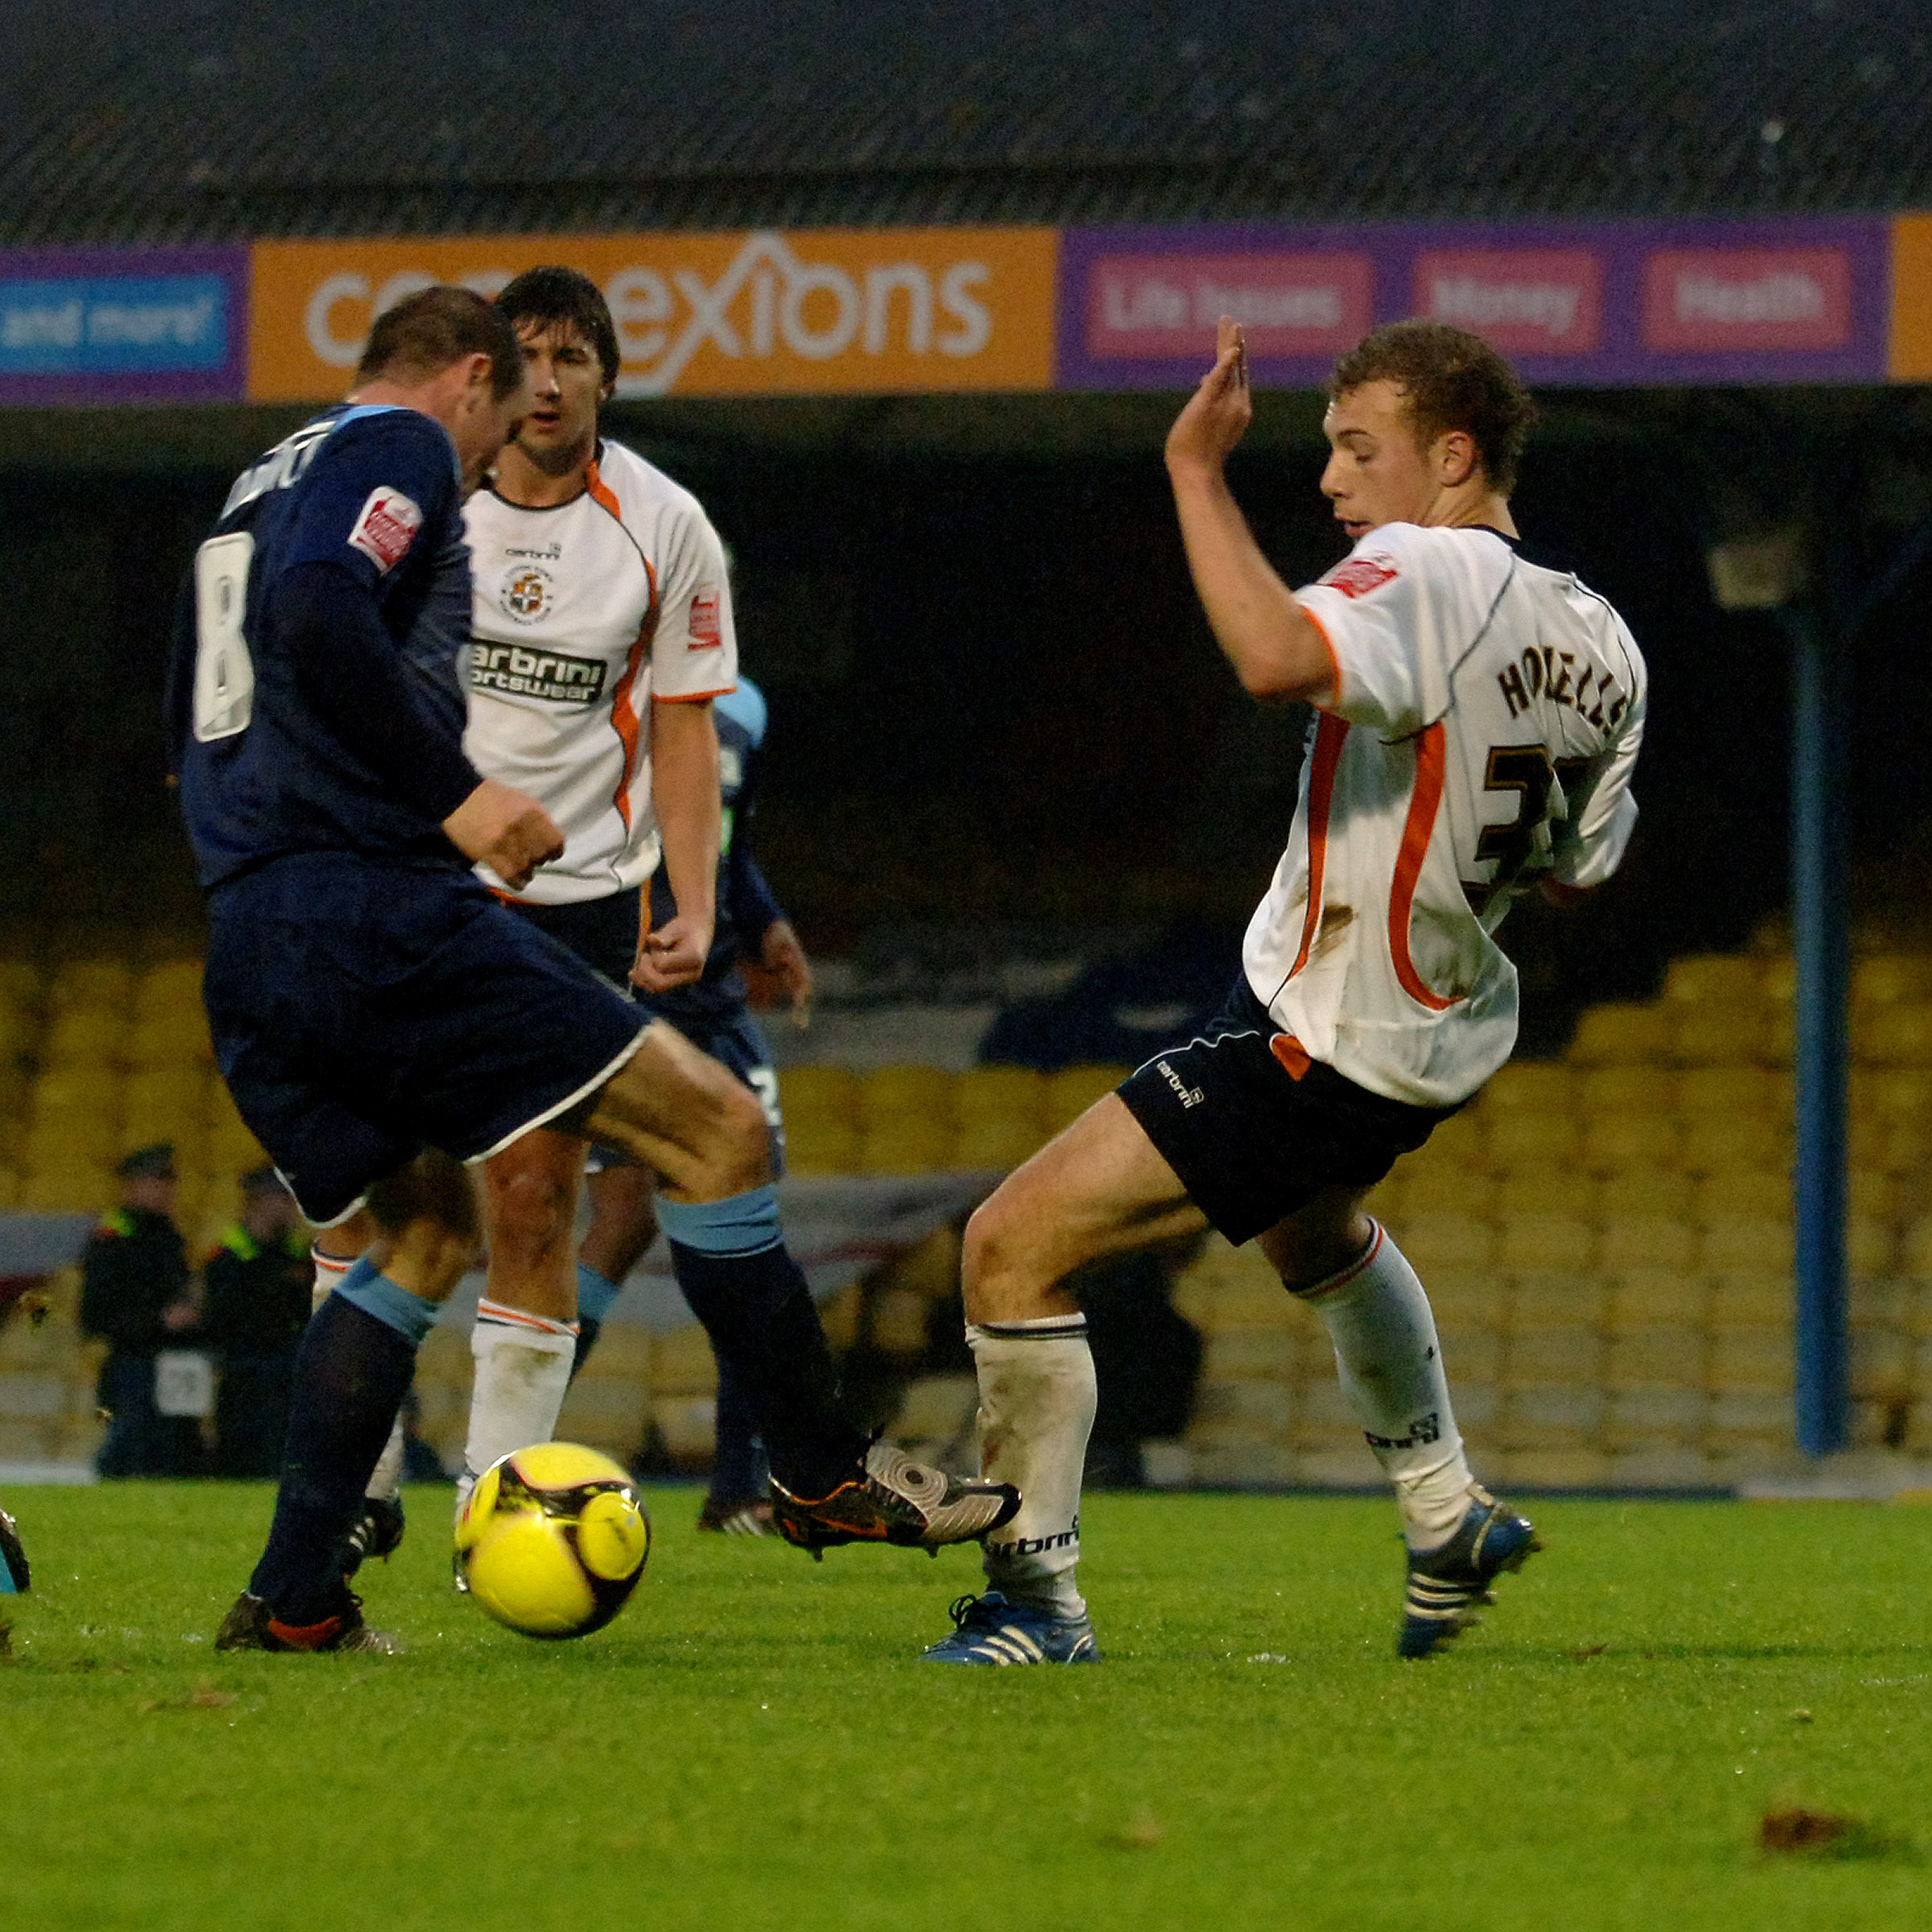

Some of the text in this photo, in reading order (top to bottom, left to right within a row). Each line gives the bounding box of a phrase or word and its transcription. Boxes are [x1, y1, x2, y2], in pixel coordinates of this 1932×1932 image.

[306, 229, 990, 400] cexions
[193, 530, 256, 743] 8
[471, 670, 596, 701] ortswear
[472, 645, 601, 684] arbrini
